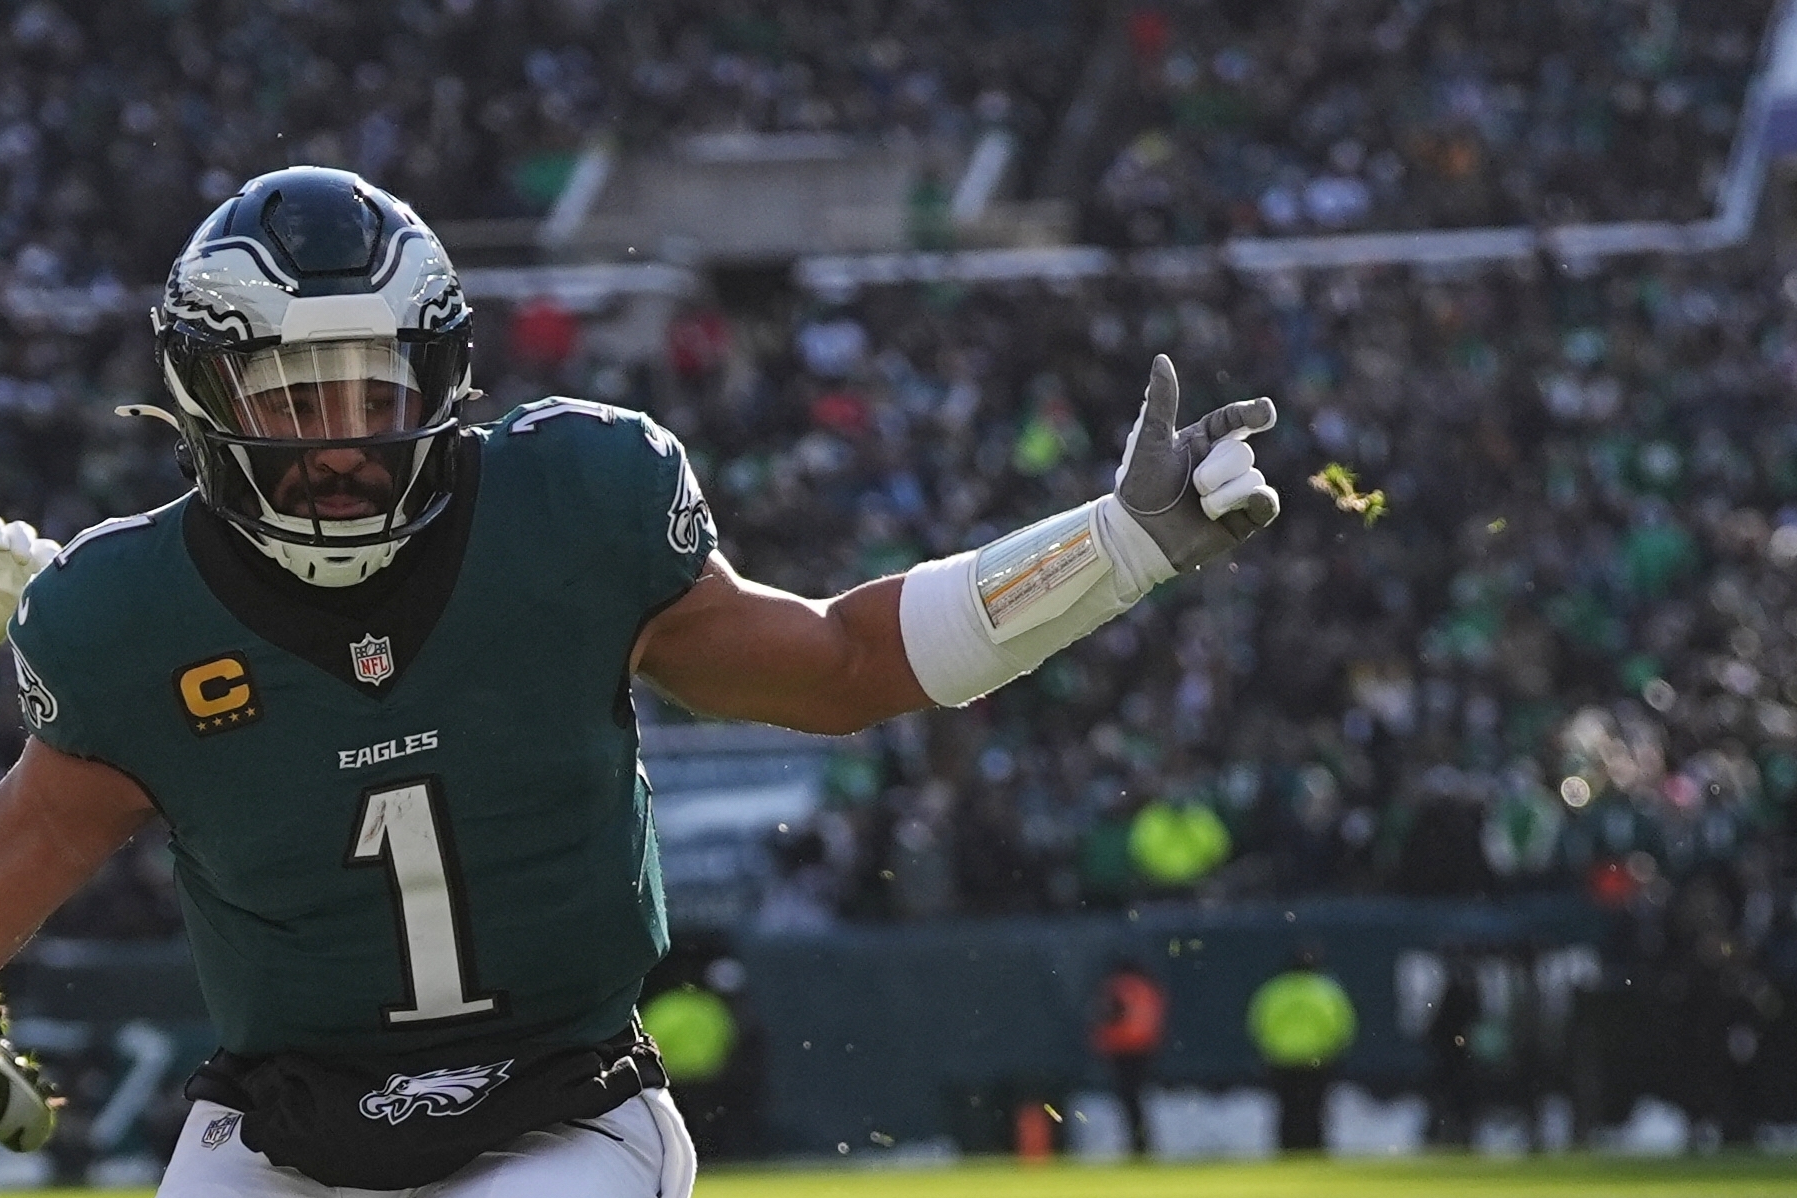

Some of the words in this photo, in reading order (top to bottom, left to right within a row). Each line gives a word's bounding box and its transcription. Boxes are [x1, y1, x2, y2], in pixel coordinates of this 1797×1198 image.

[179, 658, 251, 718] C
[360, 655, 389, 676] NFL
[337, 729, 439, 770] EAGLES
[349, 779, 498, 1027] 1
